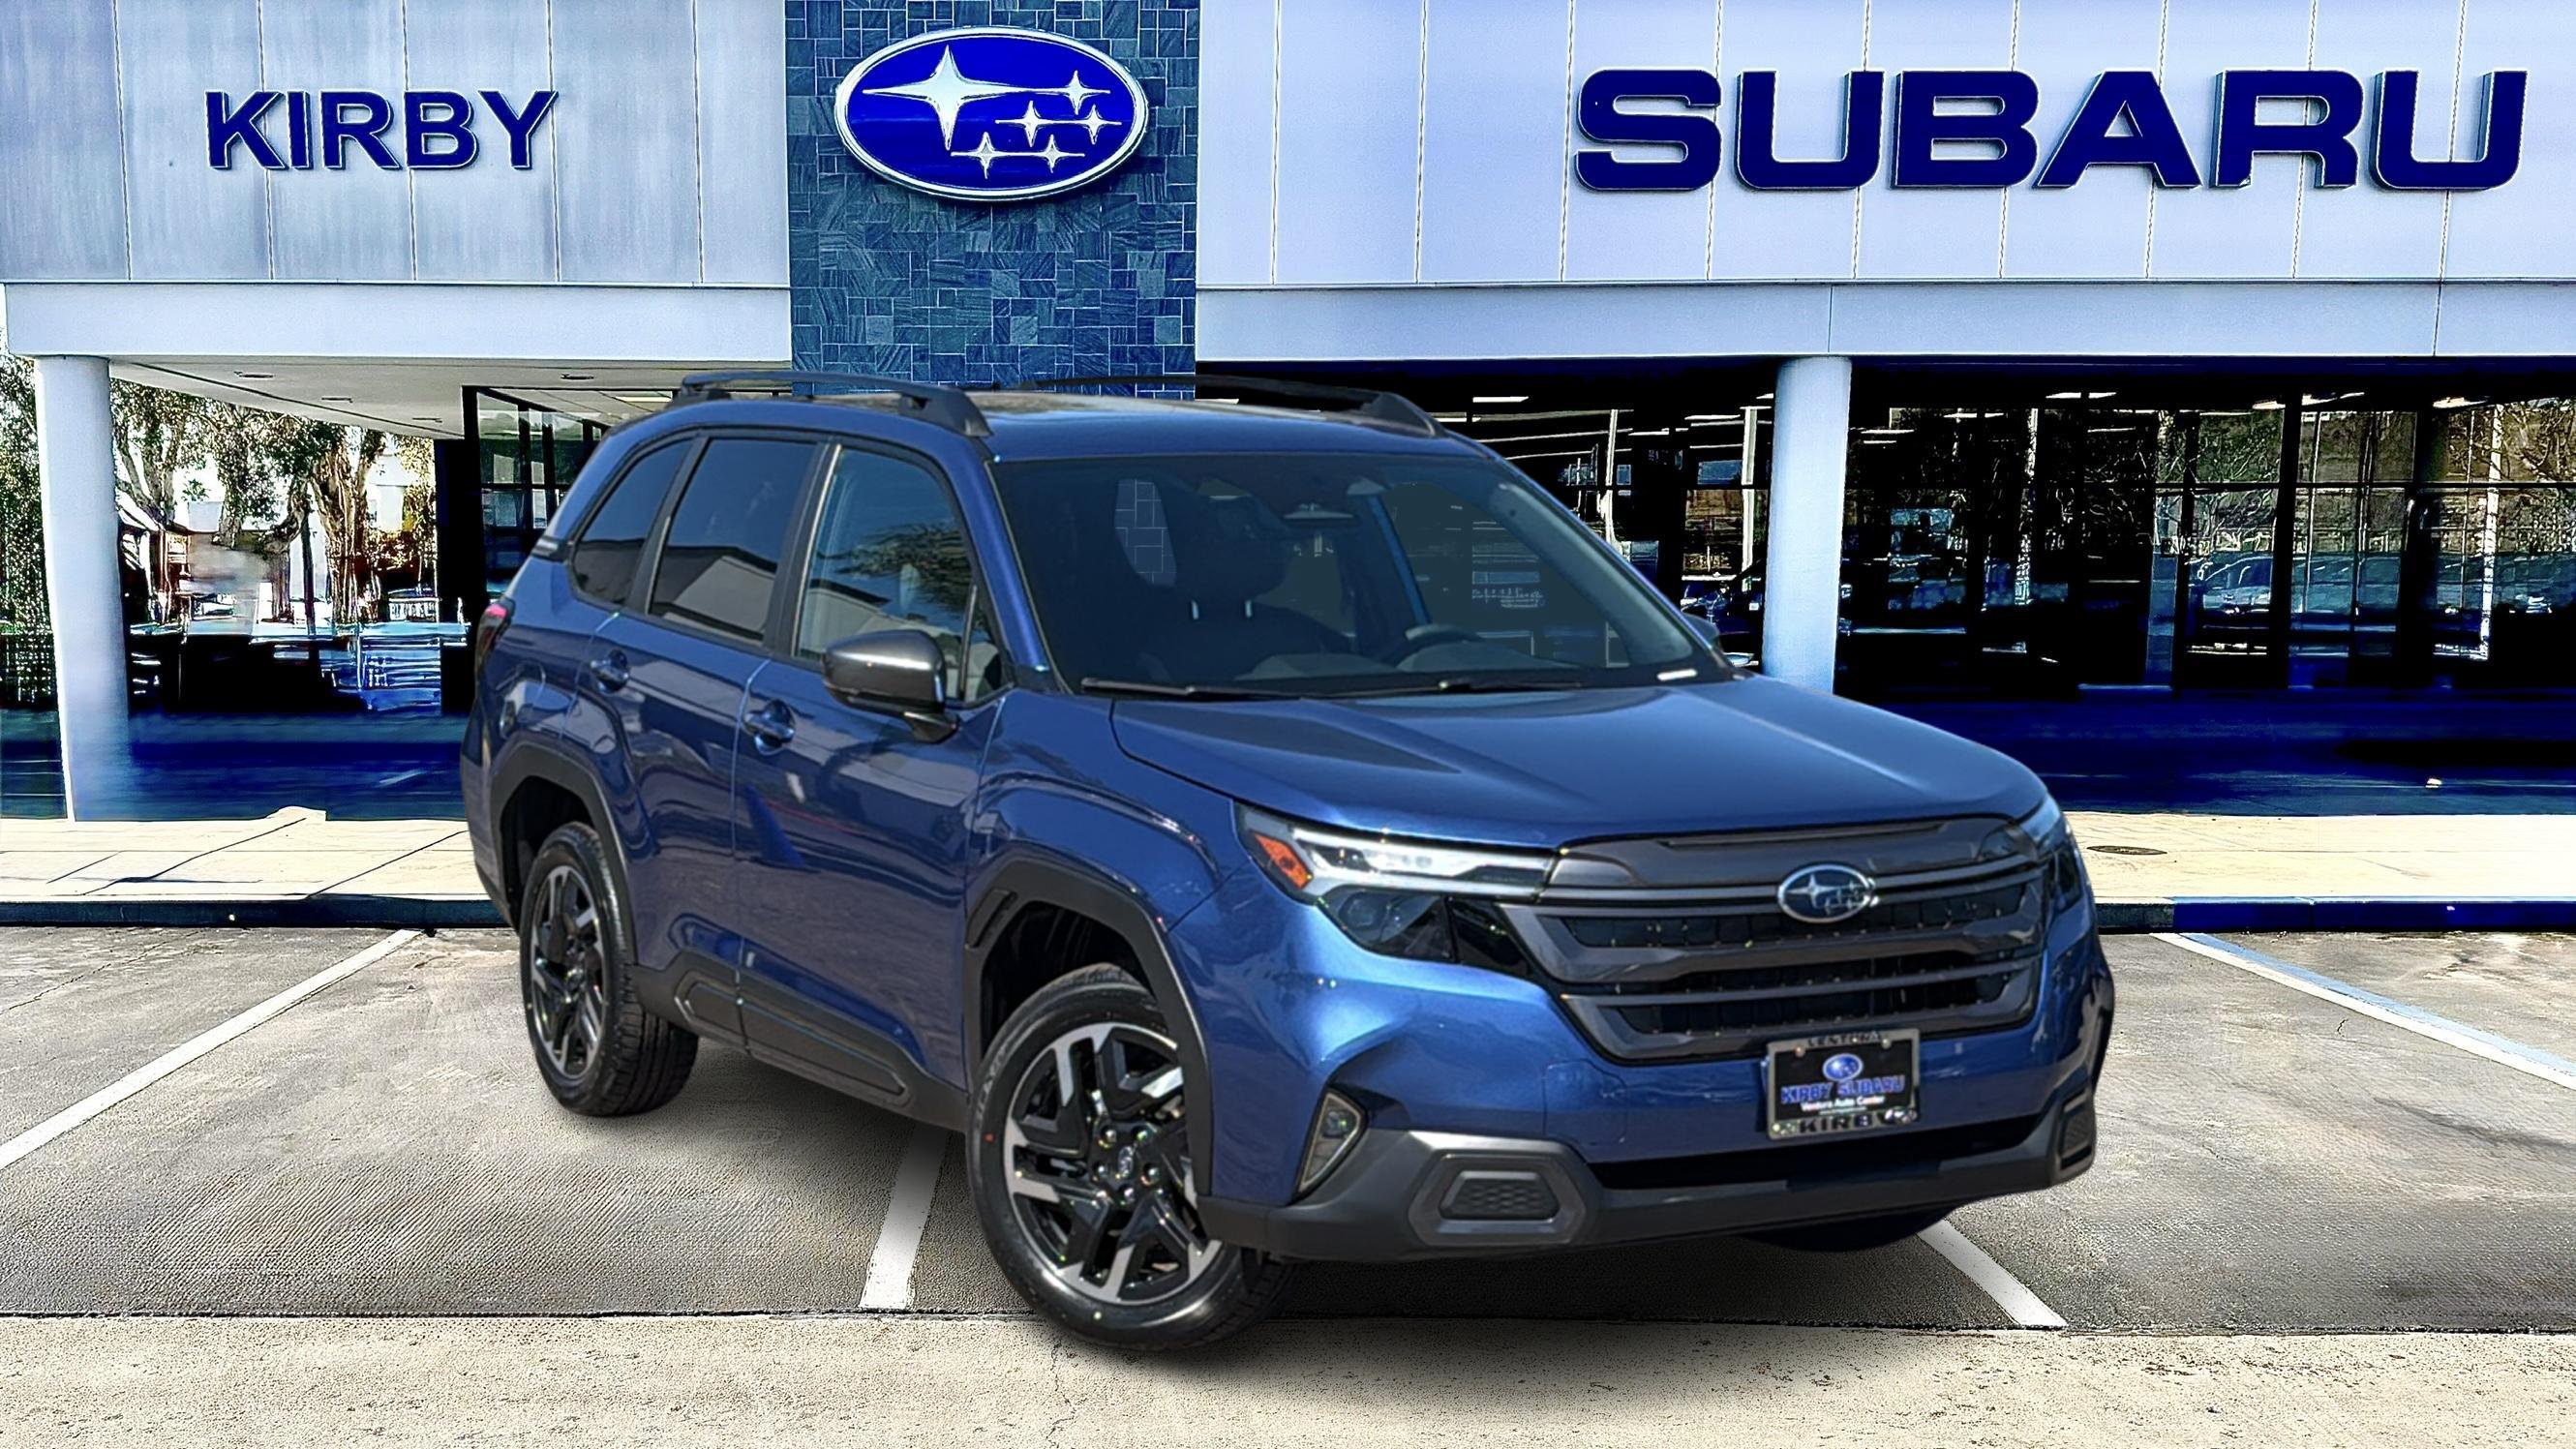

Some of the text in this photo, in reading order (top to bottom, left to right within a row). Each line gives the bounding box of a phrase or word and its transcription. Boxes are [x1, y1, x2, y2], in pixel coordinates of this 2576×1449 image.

[204, 90, 560, 170] KIRBY
[1574, 69, 2528, 191] SUBARU
[1780, 1074, 1905, 1104] KIRBY SUBARU
[1834, 1097, 1855, 1107] Auto
[1856, 1095, 1885, 1105] Center
